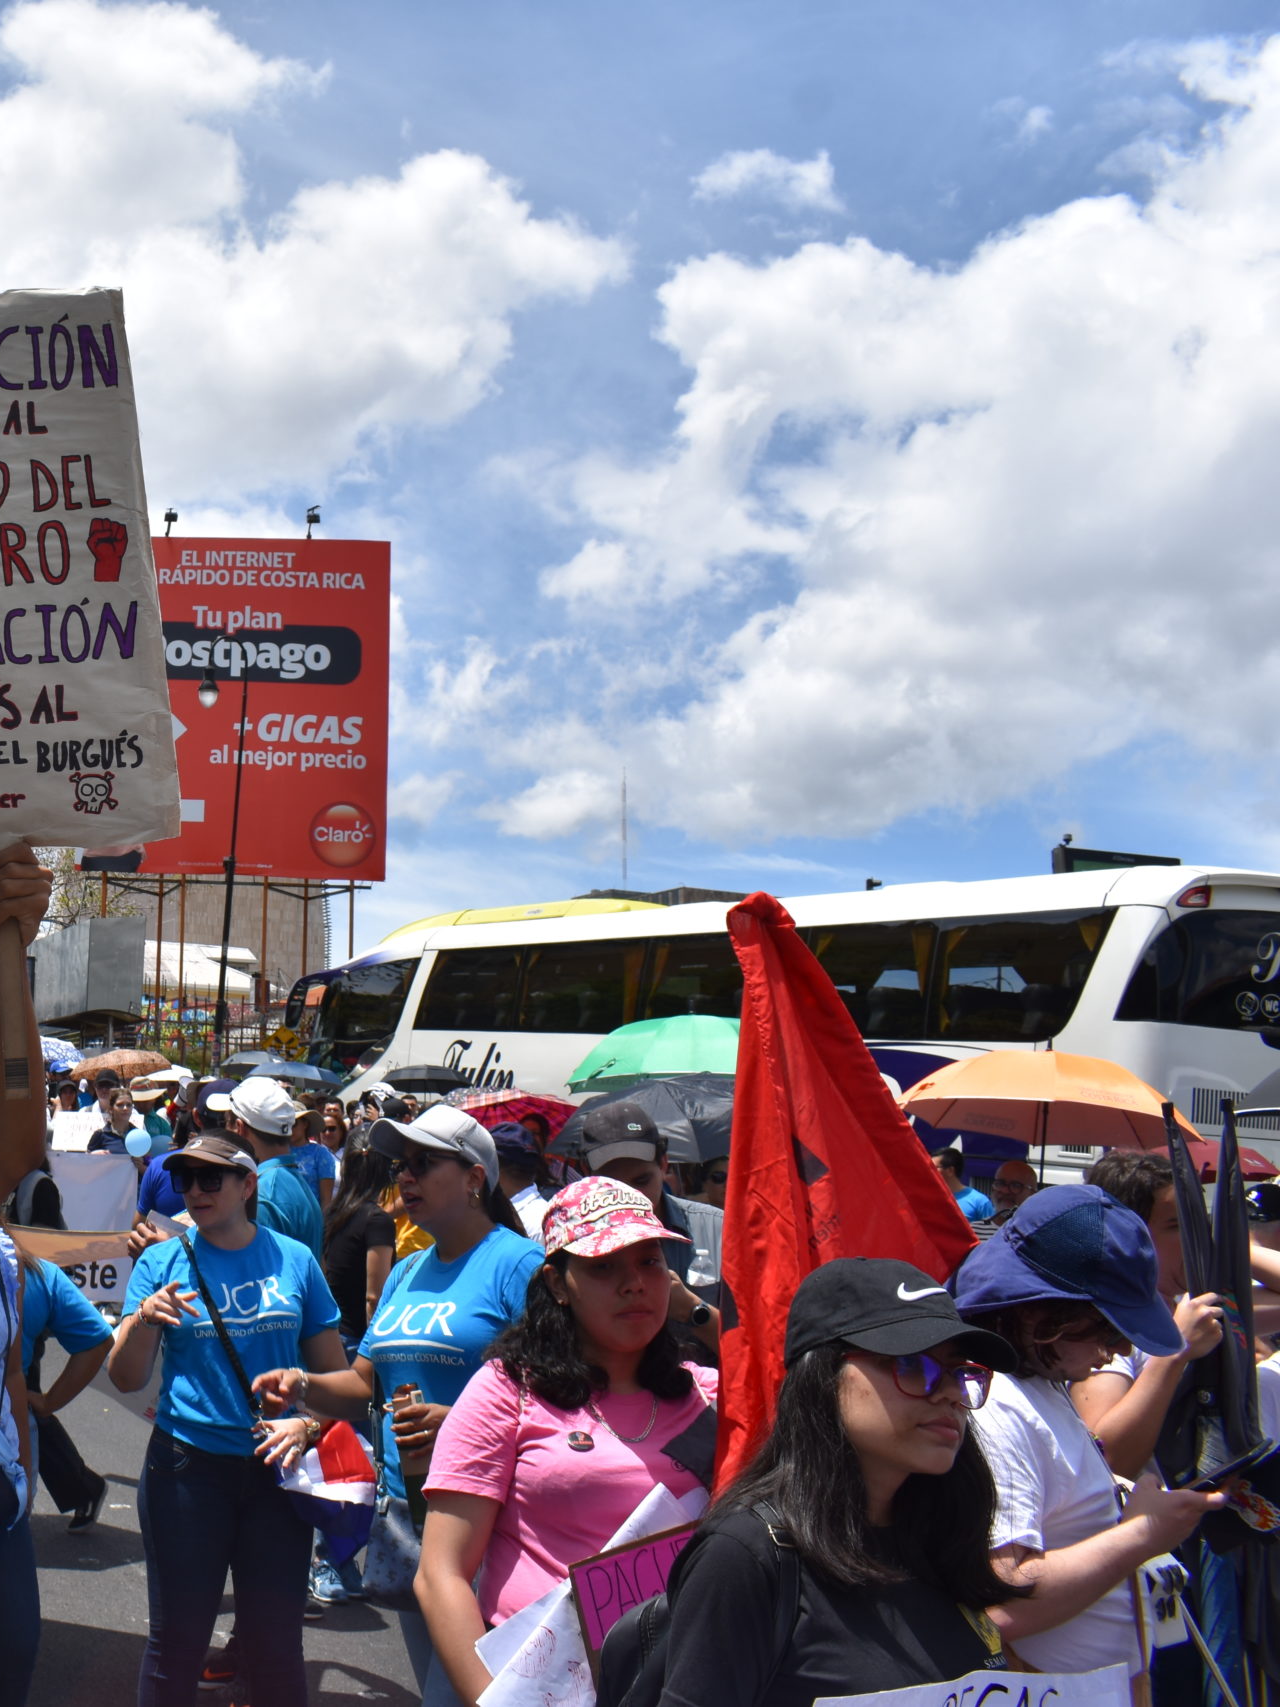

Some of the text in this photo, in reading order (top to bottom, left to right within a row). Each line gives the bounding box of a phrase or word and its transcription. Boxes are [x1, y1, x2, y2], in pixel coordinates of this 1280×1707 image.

[3, 400, 48, 435] AL
[30, 454, 111, 513] DEL
[181, 550, 296, 568] EL INTERNET
[159, 564, 366, 590] RÁPIDO DE COSTA RICA
[192, 605, 282, 634] Tu plan
[162, 634, 332, 680] ostpago
[30, 684, 78, 724] AL
[257, 713, 364, 745] GIGAS
[36, 730, 144, 773] BURGUÉS
[209, 744, 367, 772] al mejor precio
[314, 824, 365, 843] Claro
[1264, 999, 1279, 1013] WC
[65, 1261, 118, 1290] ste
[373, 1301, 457, 1337] UCR
[440, 1354, 465, 1368] RICA
